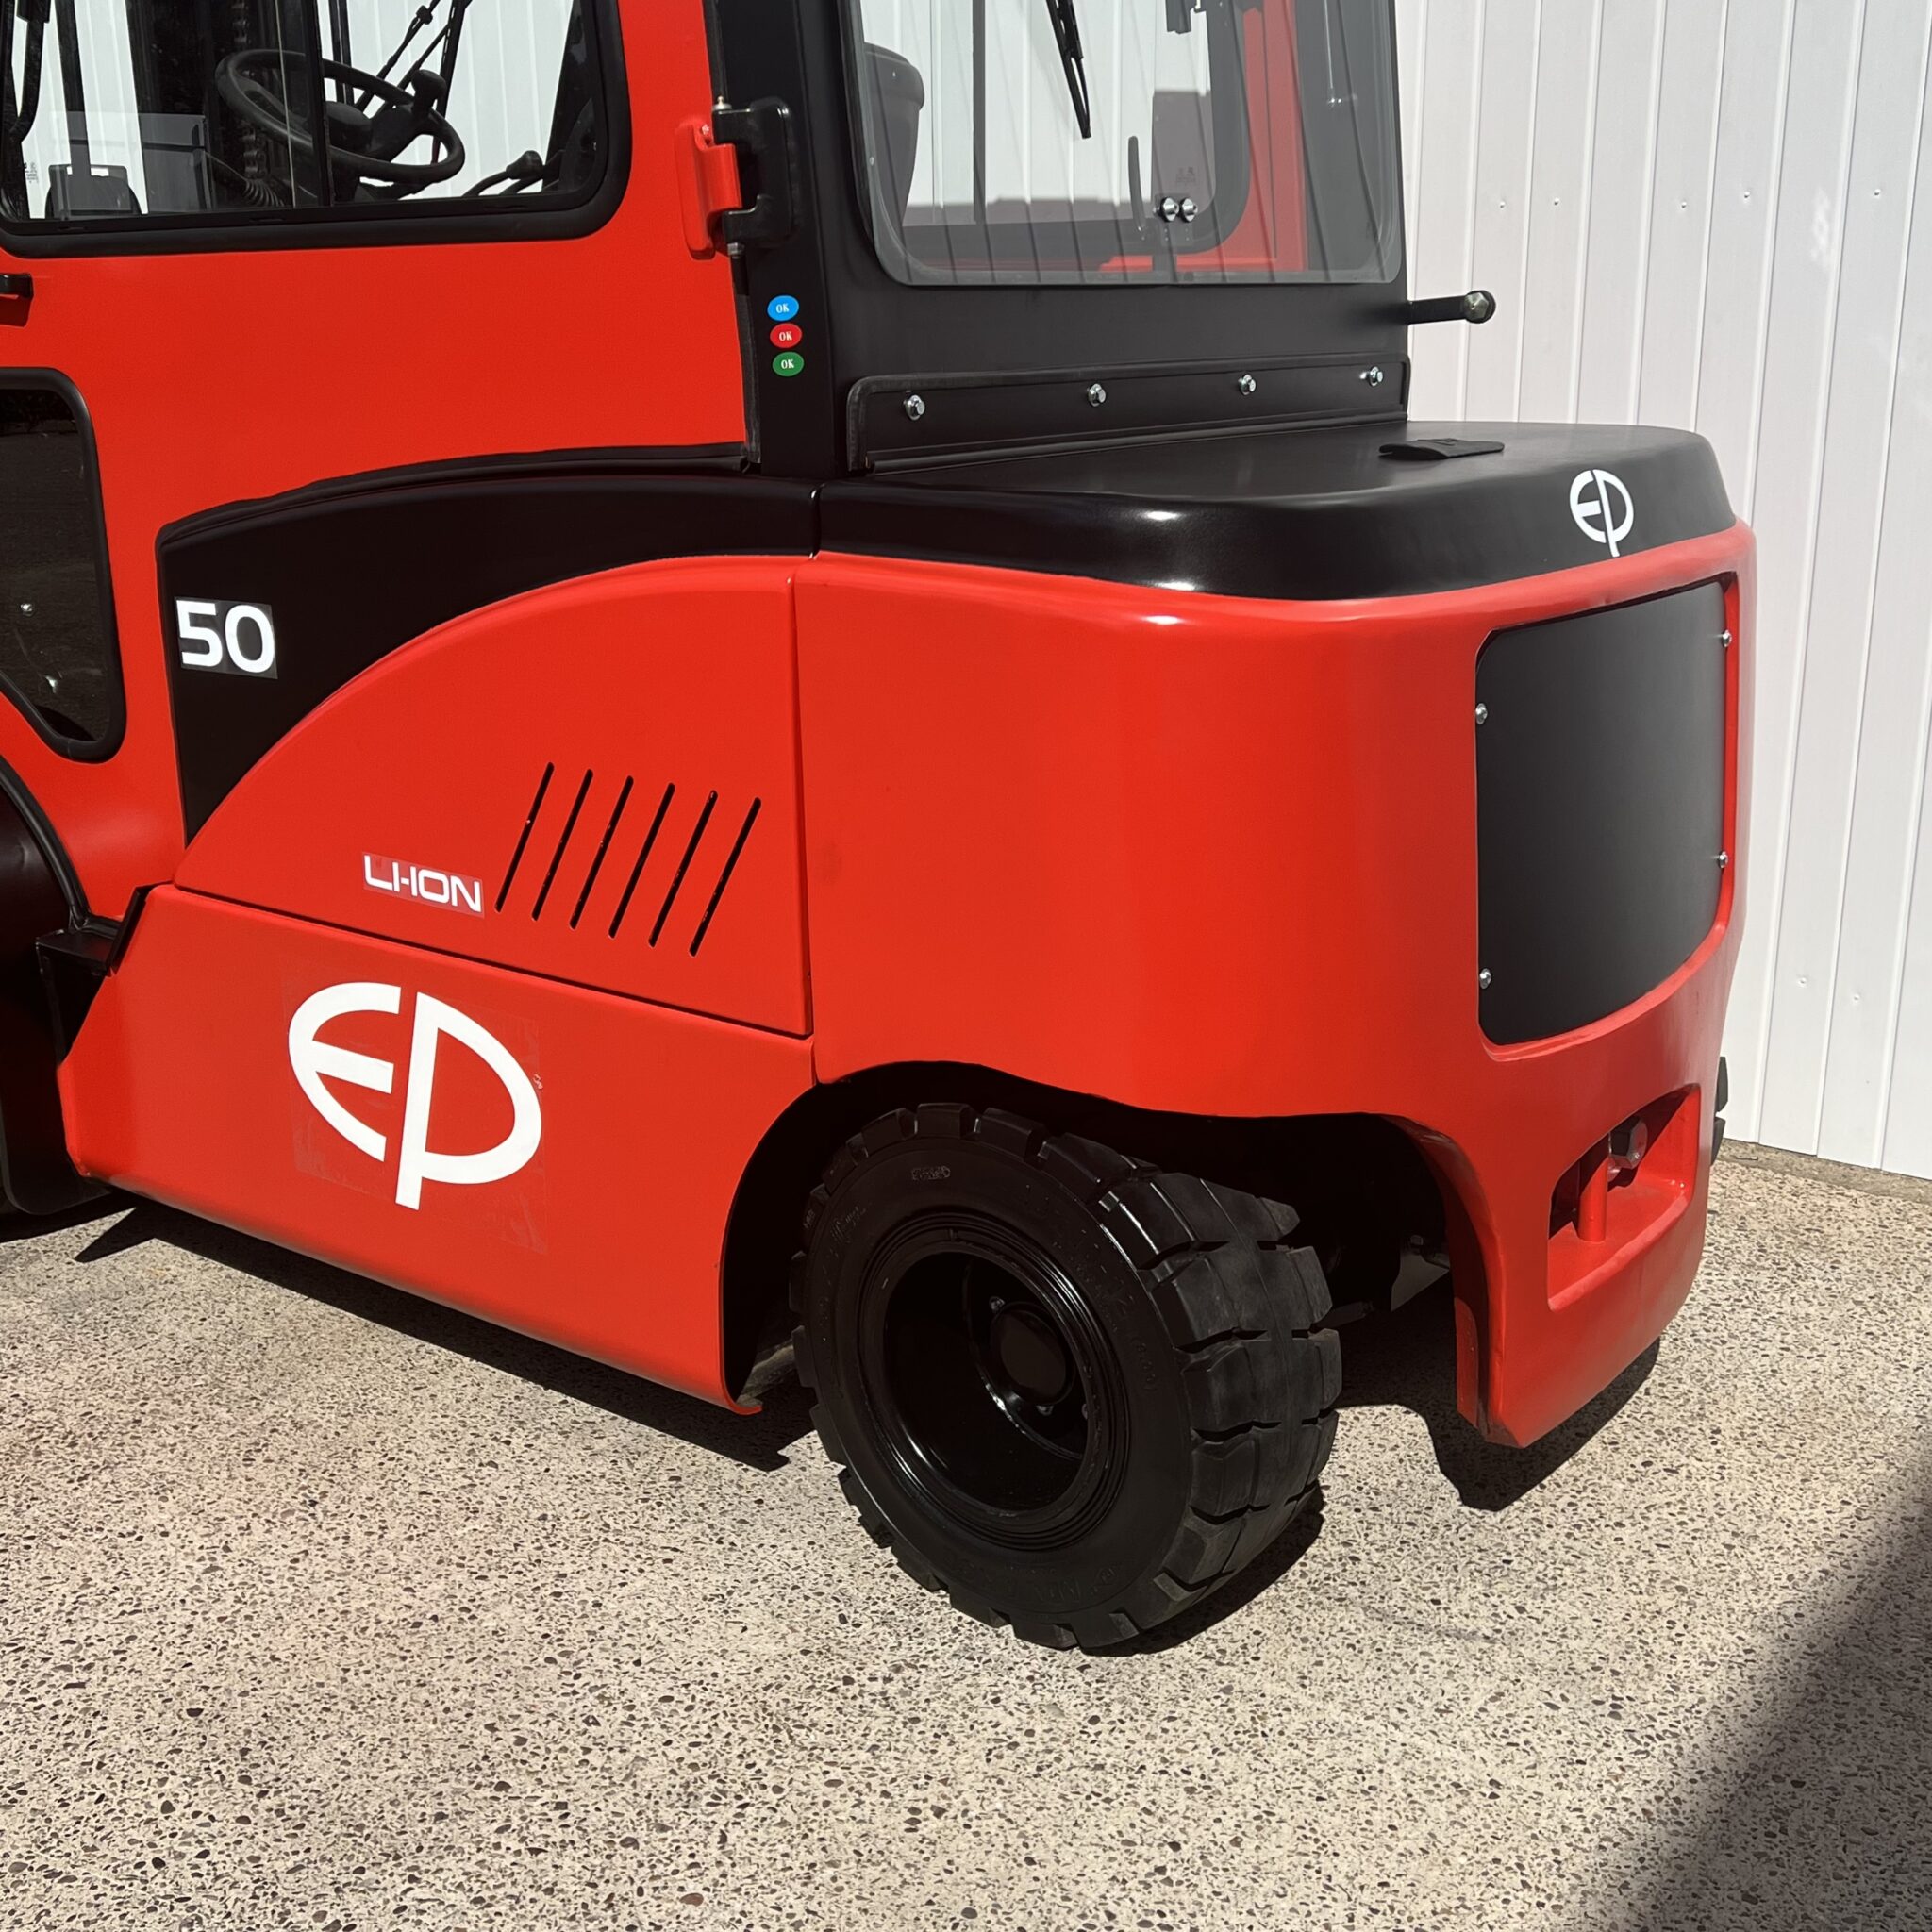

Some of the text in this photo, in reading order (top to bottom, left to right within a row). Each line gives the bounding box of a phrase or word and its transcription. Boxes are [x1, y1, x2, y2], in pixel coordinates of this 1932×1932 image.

[775, 303, 790, 314] OK
[778, 331, 792, 341] OK
[780, 359, 795, 370] OK
[1570, 469, 1634, 558] EP
[176, 600, 275, 674] 50
[288, 982, 542, 1211] EP
